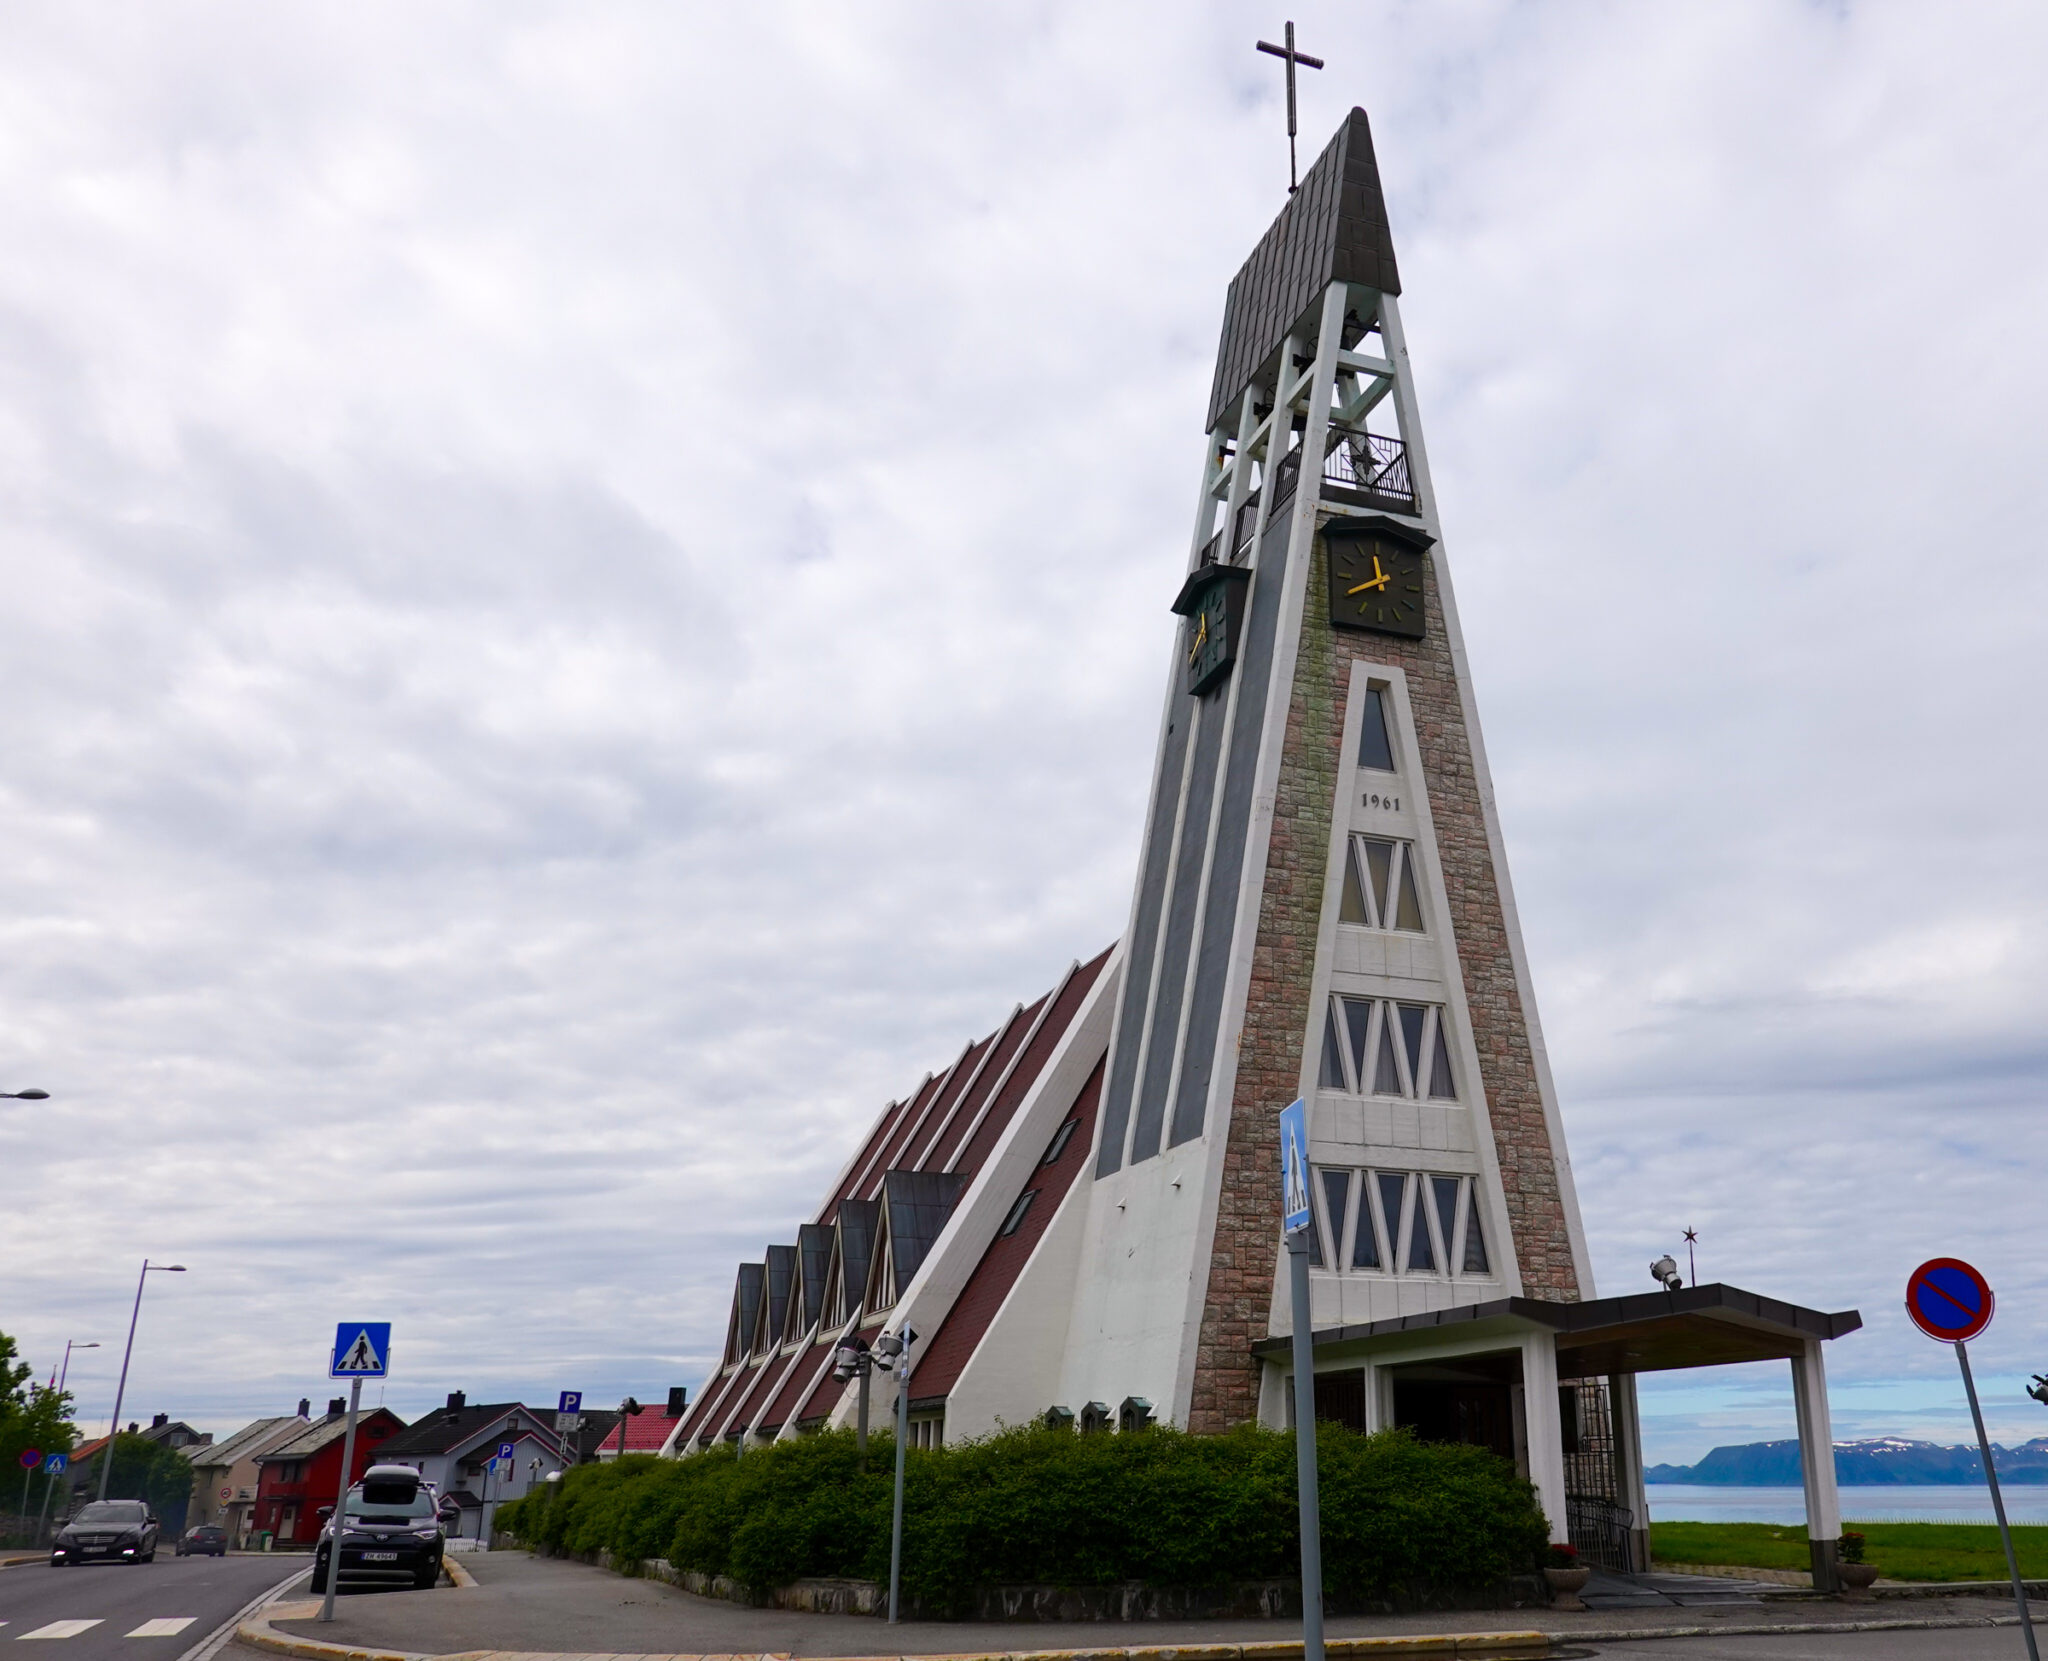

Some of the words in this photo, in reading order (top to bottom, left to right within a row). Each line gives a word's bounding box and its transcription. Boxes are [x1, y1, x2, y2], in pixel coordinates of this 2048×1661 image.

[1362, 793, 1399, 811] 1961
[564, 1394, 577, 1411] P
[501, 1444, 511, 1456] P
